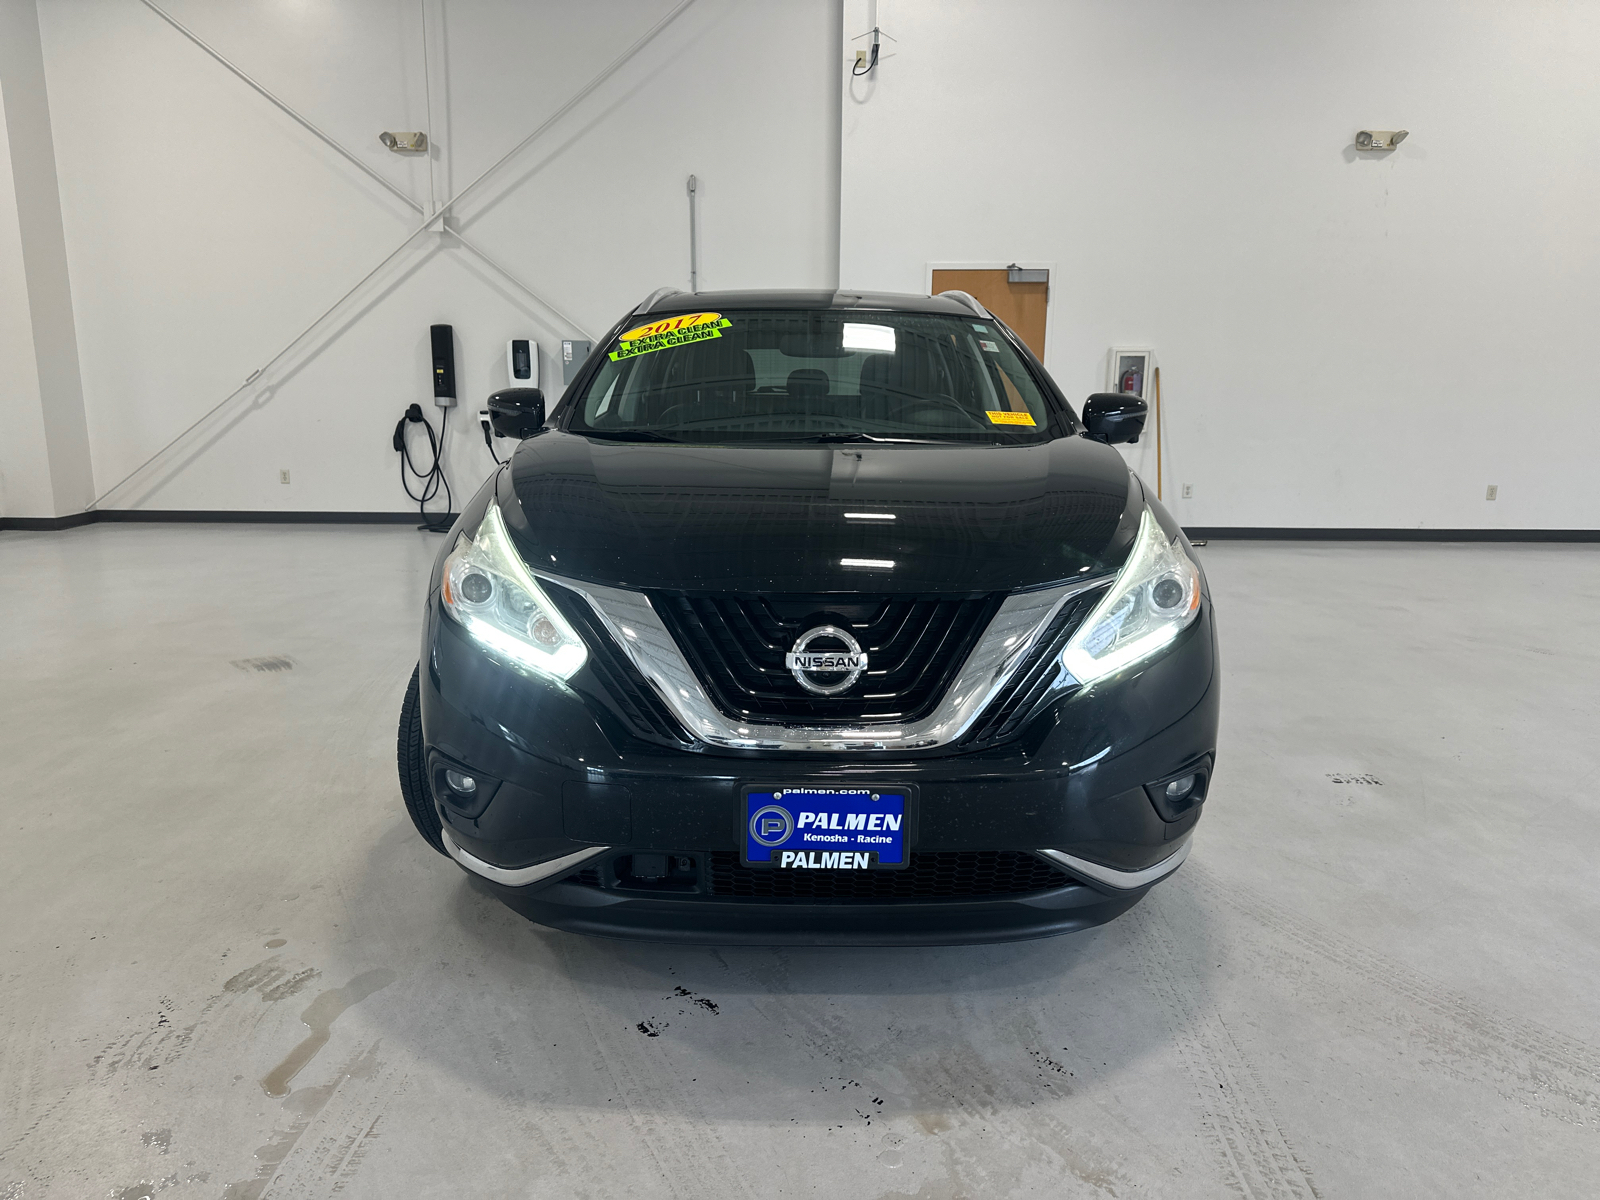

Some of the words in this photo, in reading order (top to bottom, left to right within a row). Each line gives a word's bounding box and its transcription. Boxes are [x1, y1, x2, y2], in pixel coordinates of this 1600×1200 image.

[629, 331, 676, 348] EXTRA
[677, 320, 723, 335] CLEAN
[638, 314, 702, 338] 2017
[616, 342, 666, 358] EXTRA
[667, 330, 714, 345] CLEAN
[794, 656, 859, 668] NISSAN
[761, 818, 786, 836] P
[797, 811, 902, 831] PALMEN
[803, 833, 848, 843] Kenosha
[857, 835, 893, 844] Racine
[780, 851, 870, 869] PALMEN
